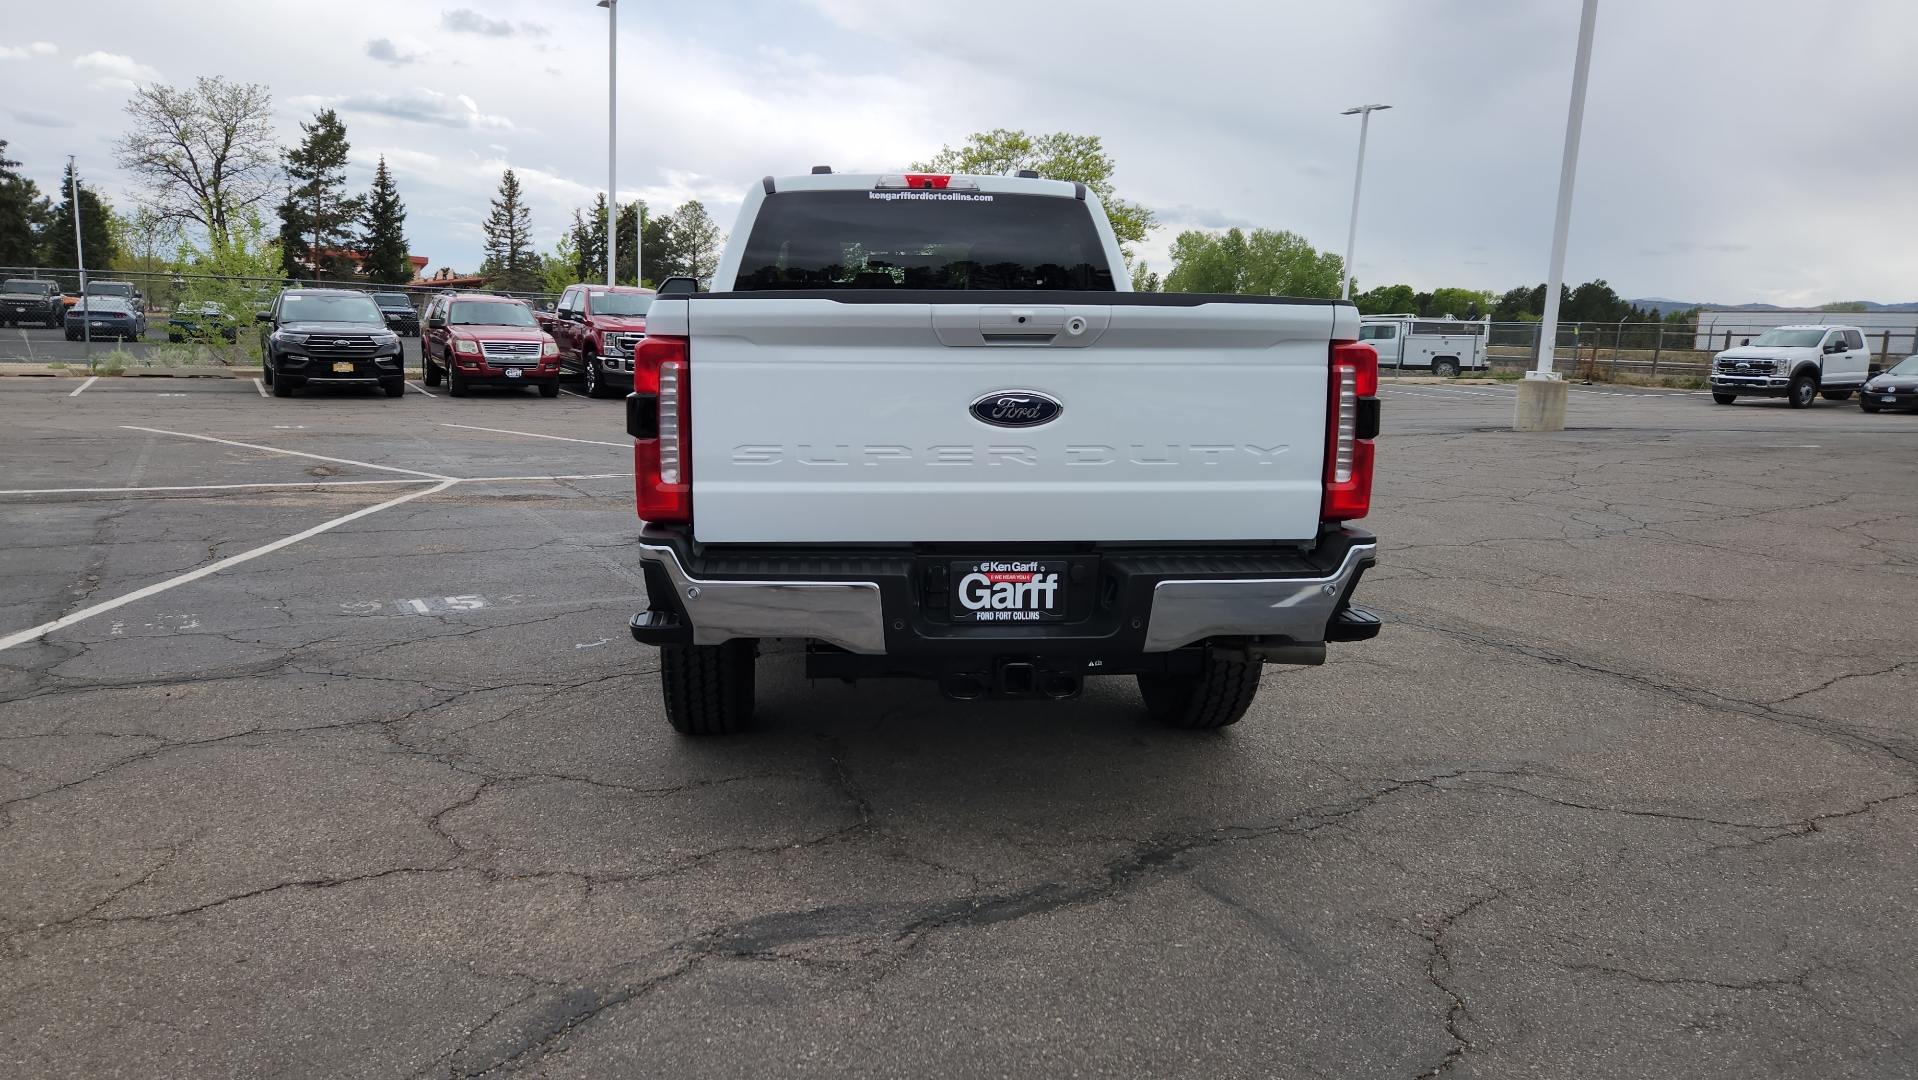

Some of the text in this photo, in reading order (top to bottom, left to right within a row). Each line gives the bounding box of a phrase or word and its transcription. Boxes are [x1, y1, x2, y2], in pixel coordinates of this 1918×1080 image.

[992, 398, 1042, 419] Ford
[733, 444, 1290, 466] SUPER DUTY
[990, 562, 1038, 572] Ken Garff
[958, 572, 1058, 610] Garff
[977, 611, 1040, 621] FORD FORT COLLINS
